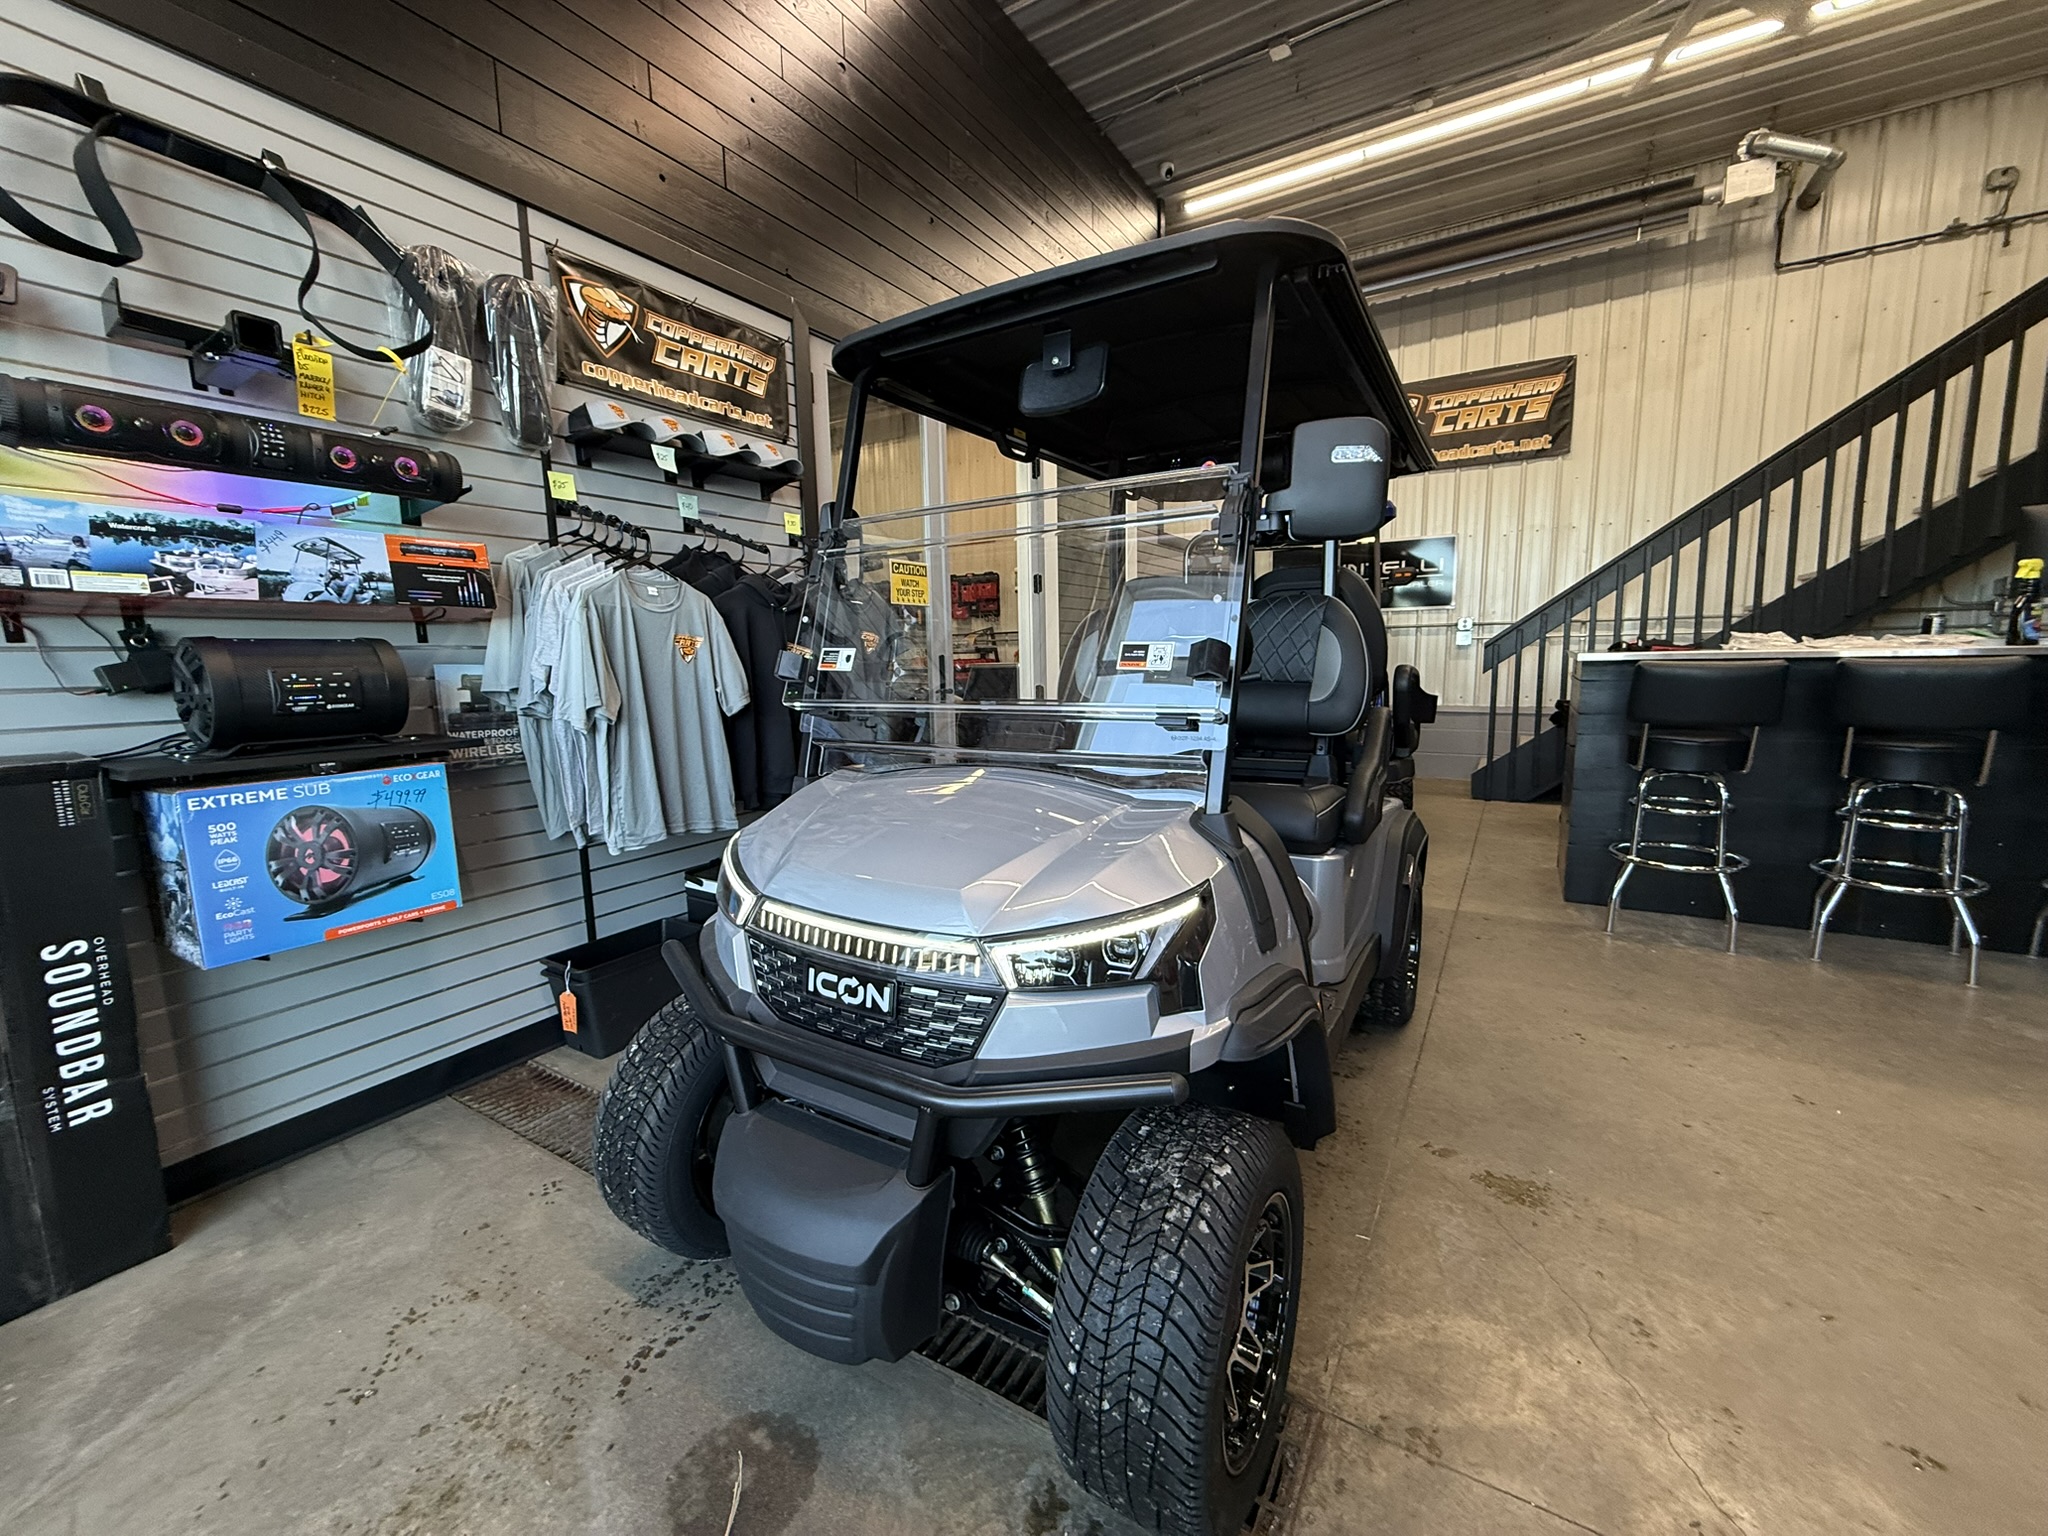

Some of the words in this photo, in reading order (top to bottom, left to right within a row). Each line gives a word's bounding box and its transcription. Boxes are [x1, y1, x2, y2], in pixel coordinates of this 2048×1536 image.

[647, 312, 776, 373] COPPERHEAD
[654, 337, 767, 396] CARTS
[581, 360, 774, 429] copperheadcarts.net
[1429, 376, 1563, 410] COPPERHEAD
[302, 403, 329, 416] $225
[1433, 394, 1552, 434] CARTS
[108, 522, 156, 532] Watercrafts
[258, 529, 287, 554] $449
[892, 563, 926, 576] CAUTION
[901, 578, 919, 588] WATCH
[896, 587, 910, 597] YOUR
[912, 590, 924, 598] STEP
[447, 728, 519, 739] WATERPROOF
[449, 743, 522, 759] WIRELESS
[187, 788, 288, 811] EXTREME
[293, 783, 331, 798] SUB
[367, 788, 427, 809] $499.99
[208, 822, 237, 833] 500
[210, 831, 237, 839] WATTS
[210, 837, 238, 846] PEAK
[215, 907, 256, 920] EcoCast
[387, 913, 403, 923] GOLF
[425, 905, 446, 914] MARINE
[223, 928, 253, 939] PARTY
[224, 933, 255, 945] LIGHTS
[93, 936, 114, 1006] OVERHEAD
[808, 967, 891, 1013] ICON
[40, 939, 113, 1127] SOUNDBAR
[42, 1086, 62, 1133] SYSTEM
